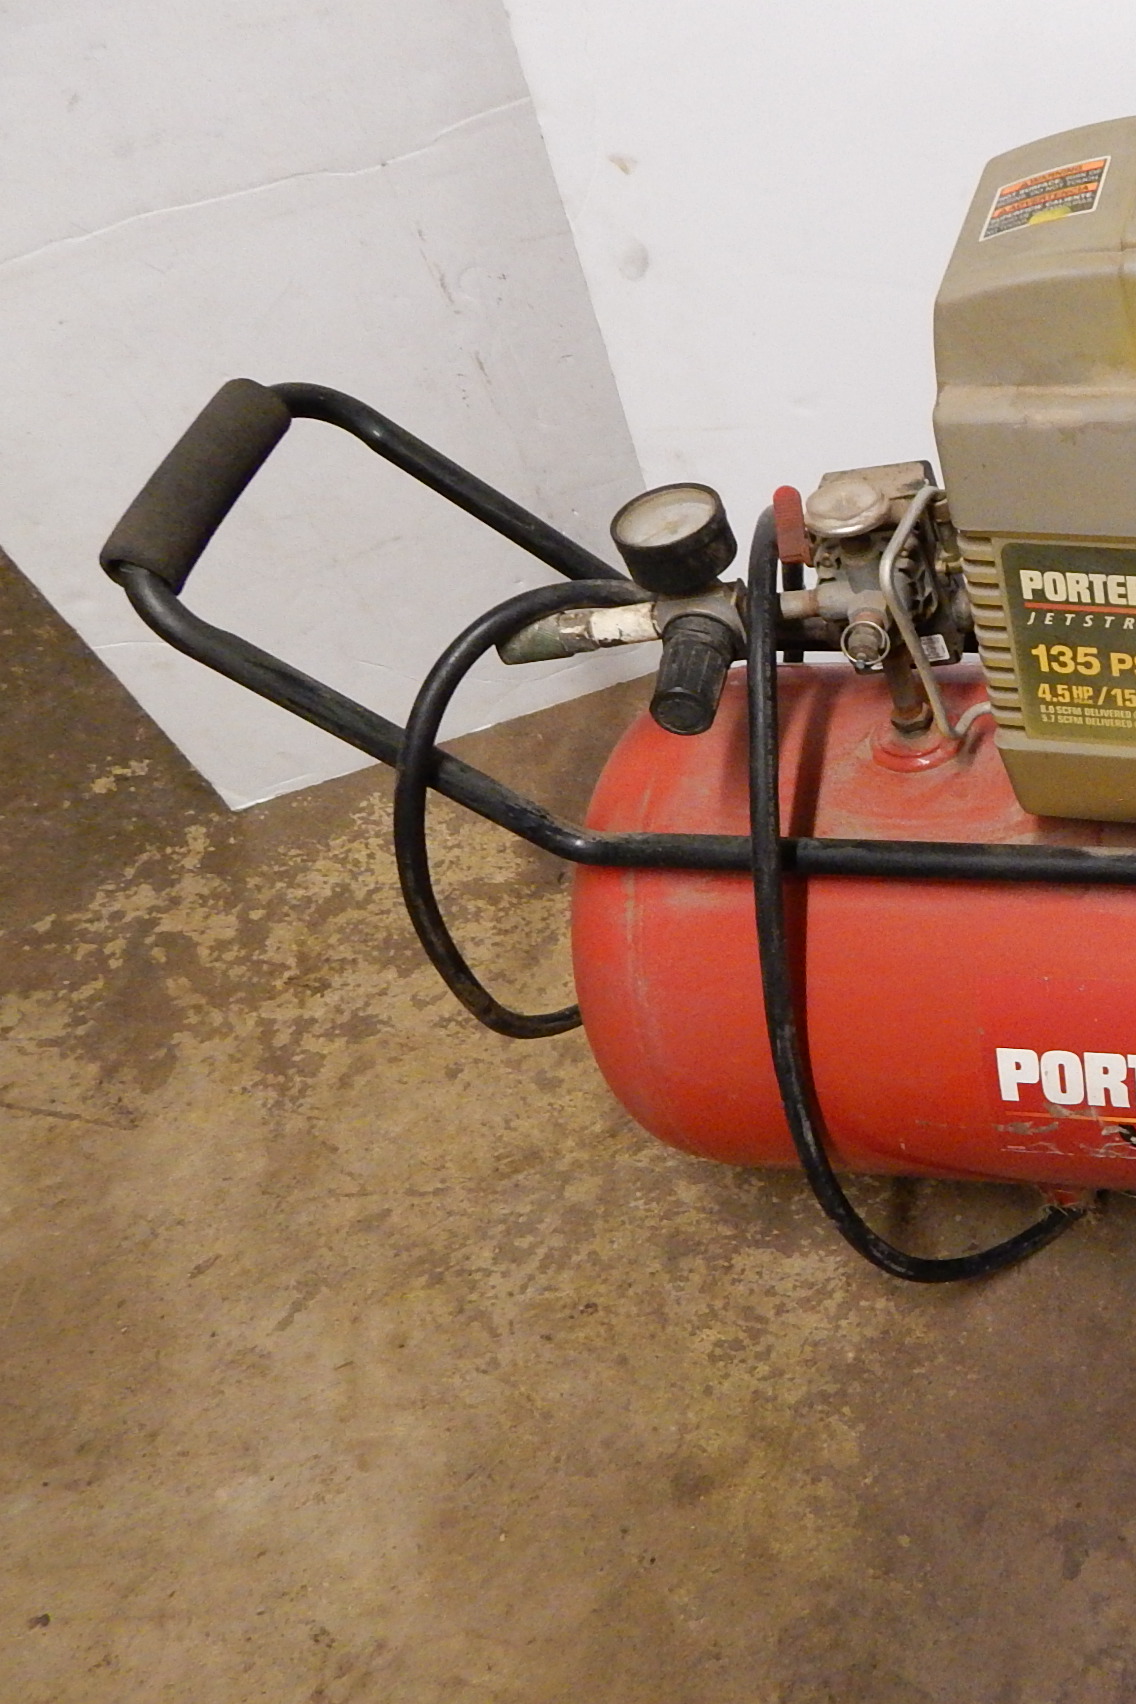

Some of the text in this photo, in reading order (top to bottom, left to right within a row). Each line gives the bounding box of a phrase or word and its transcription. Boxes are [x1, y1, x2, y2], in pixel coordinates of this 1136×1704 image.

[1031, 644, 1101, 676] 135
[1084, 708, 1132, 719] DELIVERED
[1085, 717, 1133, 728] DELIVERED
